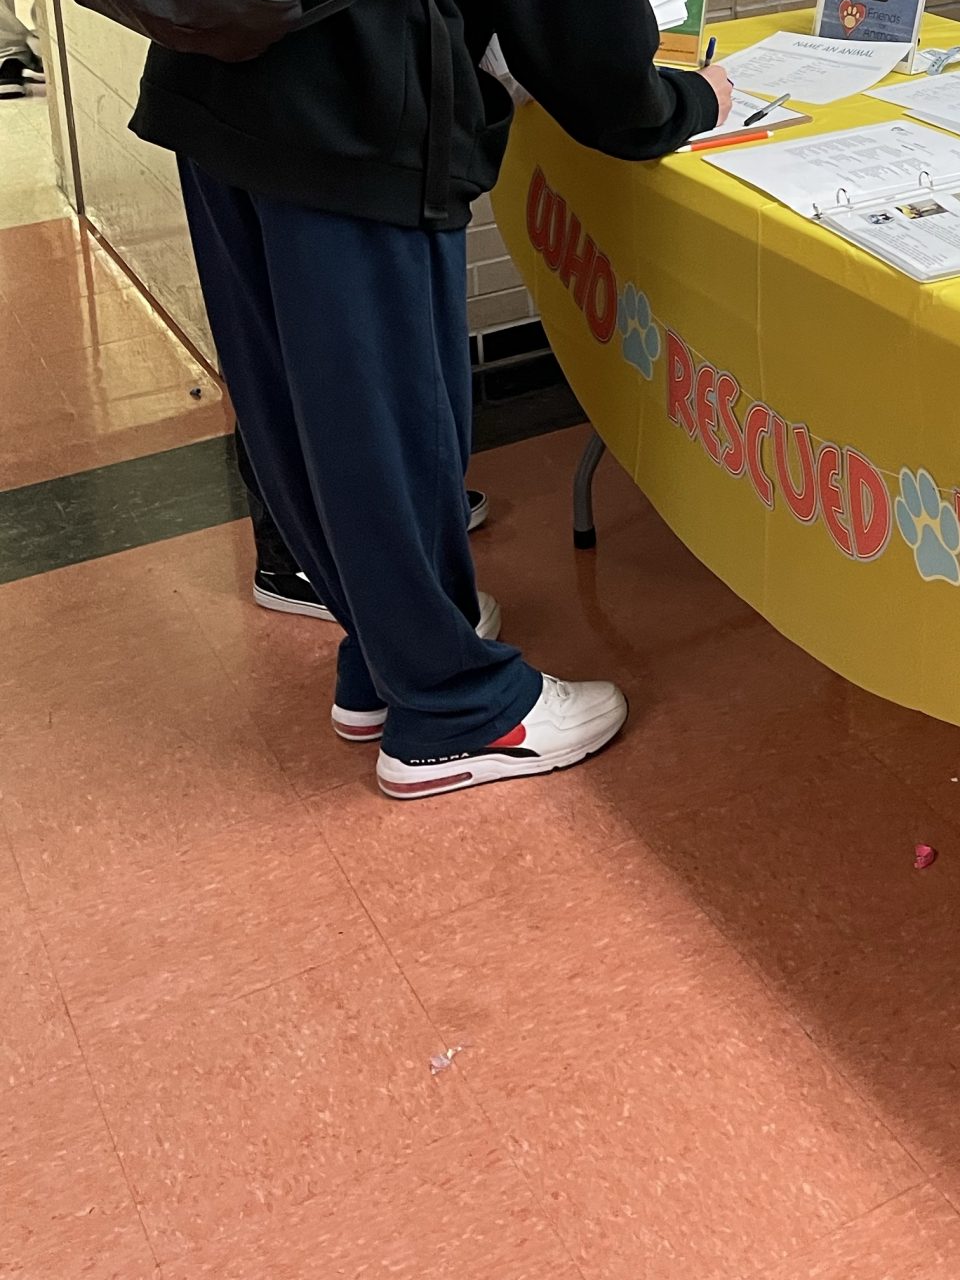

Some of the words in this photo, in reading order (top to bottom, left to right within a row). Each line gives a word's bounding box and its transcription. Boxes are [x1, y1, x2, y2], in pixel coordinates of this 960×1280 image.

[867, 7, 901, 24] Friends
[793, 41, 822, 50] NAME
[837, 48, 874, 58] ANIMAL
[526, 166, 619, 344] WHO
[666, 328, 892, 561] RESCUED
